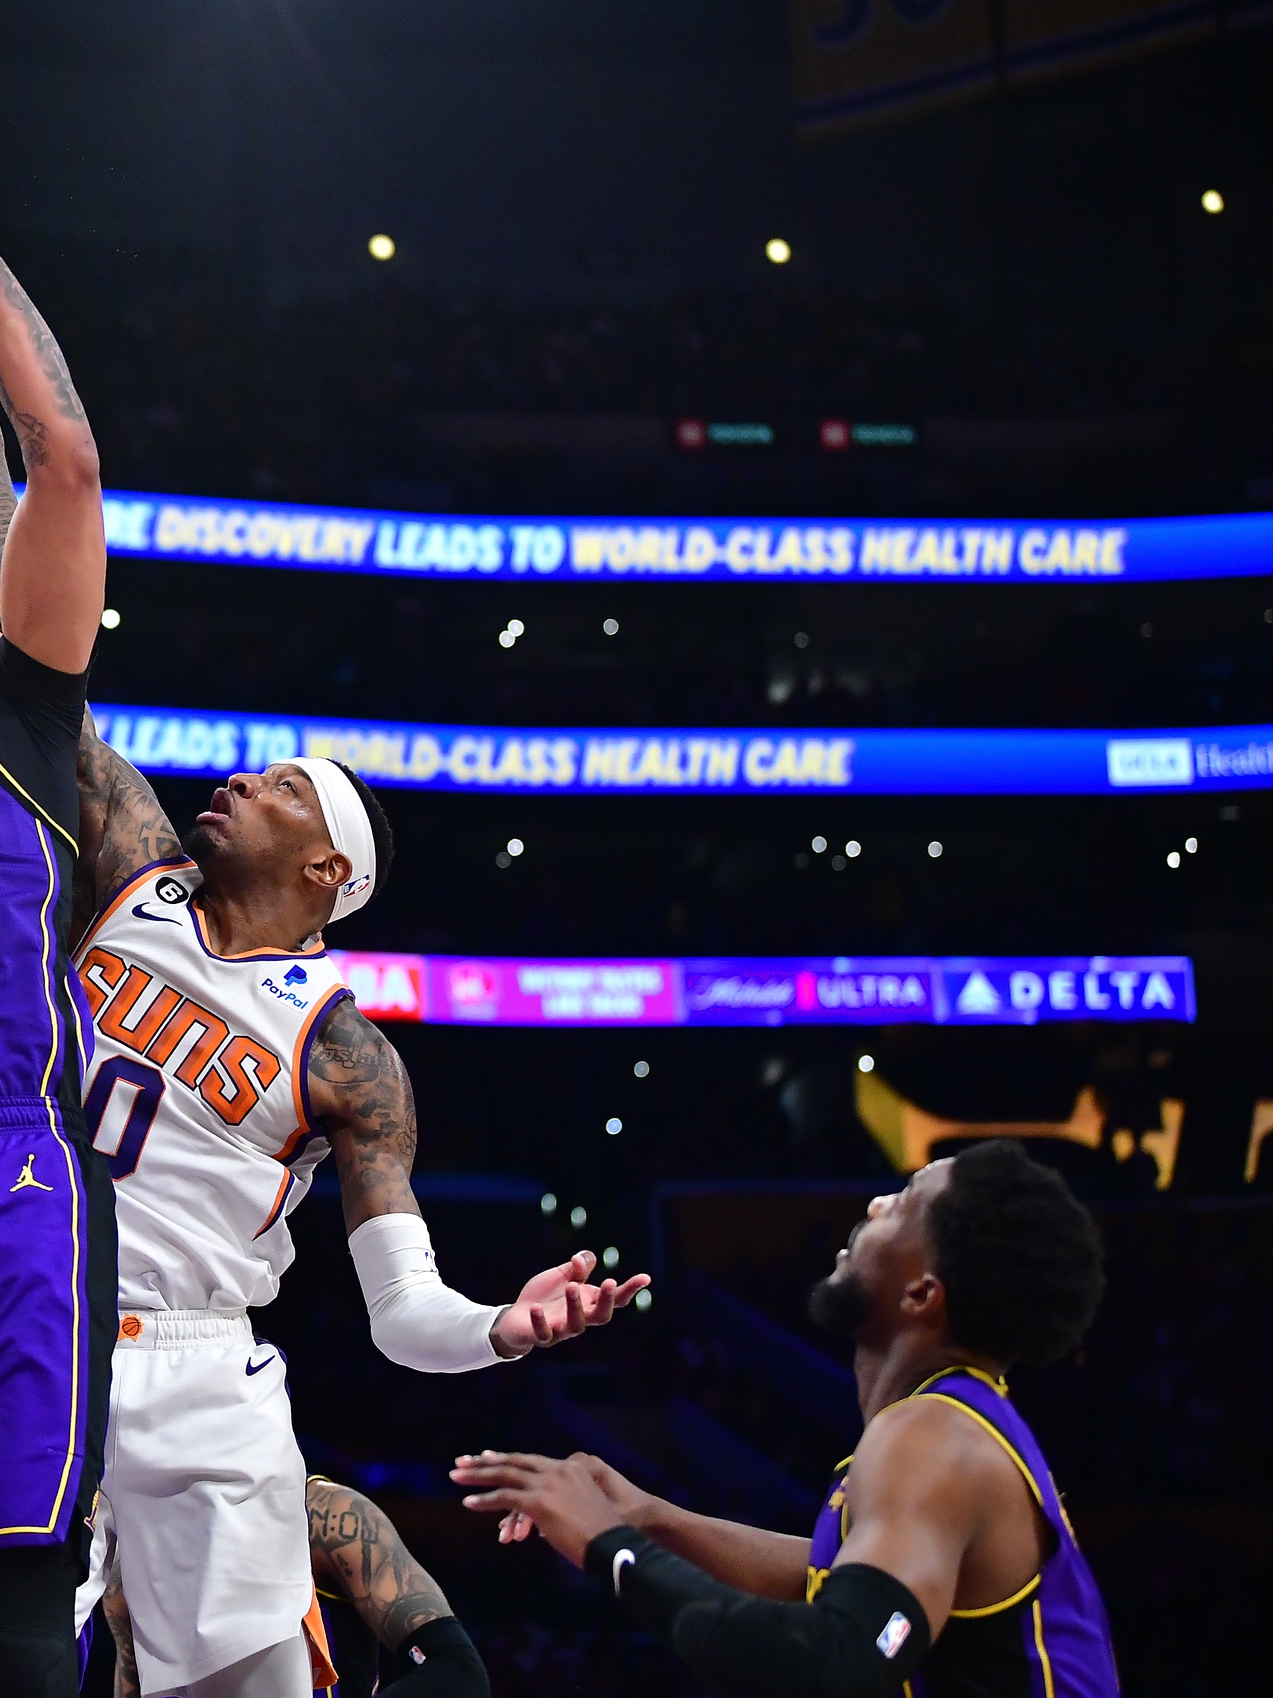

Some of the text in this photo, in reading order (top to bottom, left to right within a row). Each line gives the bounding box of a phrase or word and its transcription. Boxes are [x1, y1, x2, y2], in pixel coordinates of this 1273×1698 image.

[154, 505, 375, 566] DISCOVERY
[374, 519, 505, 574] LEADS
[507, 523, 564, 574] TO
[571, 525, 854, 576] WORLD-CLASS
[859, 526, 1015, 575] HEALTH
[1017, 526, 1128, 577] CARE
[108, 714, 238, 771] LEADS
[243, 722, 298, 772] TO
[300, 730, 578, 785] WORLD-CLASS
[582, 738, 740, 787] HEALTH
[742, 738, 856, 787] CARE
[261, 977, 309, 1011] PayPal
[816, 973, 926, 1009] ULTRA
[1009, 971, 1177, 1011] DELTA
